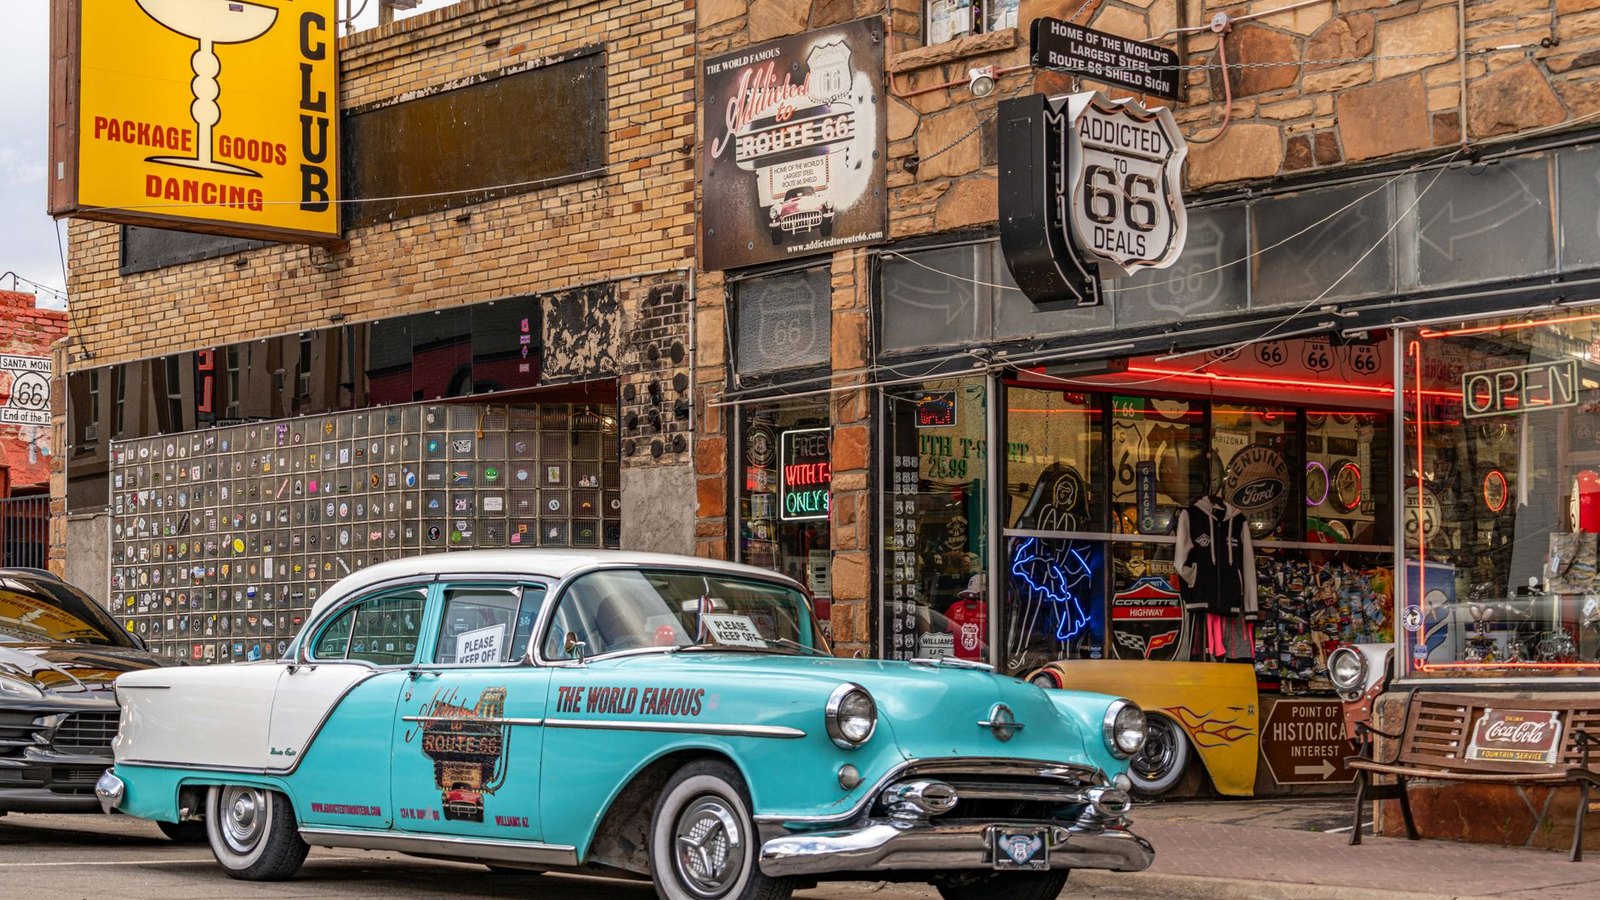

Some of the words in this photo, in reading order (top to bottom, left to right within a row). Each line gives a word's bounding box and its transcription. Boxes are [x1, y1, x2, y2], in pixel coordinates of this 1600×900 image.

[1051, 22, 1083, 42] HOME
[1085, 31, 1100, 45] OF
[1101, 36, 1121, 51] THE
[1123, 41, 1169, 64] WORLD'S
[706, 65, 721, 76] THE
[722, 56, 748, 72] WORLD
[750, 48, 781, 63] FAMOUS
[1070, 42, 1116, 65] LARGEST
[1118, 54, 1151, 73] STEEL
[1049, 52, 1085, 71] ROUTE
[1087, 60, 1104, 76] 66
[1105, 65, 1143, 86] SHIELD
[1144, 77, 1170, 93] SIGN
[299, 12, 329, 213] CLUB
[712, 61, 811, 158] Addicted
[775, 104, 798, 123] to
[94, 116, 192, 152] PACKAGE
[742, 122, 814, 158] ROUTE
[822, 115, 849, 141] 66
[1080, 116, 1162, 154] ADDICTED
[218, 135, 287, 166] GOODS
[774, 165, 788, 175] HOME
[787, 163, 795, 173] OF
[795, 161, 804, 171] THE
[783, 171, 801, 181] LARGEST
[802, 169, 814, 178] STEEL
[1113, 157, 1128, 174] TO
[145, 174, 263, 212] DANCING
[782, 179, 796, 188] ROUTE
[802, 176, 817, 185] SHIELD
[1083, 165, 1160, 232] 66
[787, 230, 883, 253] www.addictedtoroute66.com
[1094, 226, 1146, 257] DEALS
[3, 358, 27, 369] SANTA
[1261, 345, 1282, 363] 66
[1308, 351, 1329, 368] 66
[1355, 355, 1375, 371] 66
[18, 382, 42, 407] 66
[1468, 364, 1571, 413] OPEN
[3, 410, 19, 421] End
[20, 411, 29, 421] of
[30, 412, 42, 423] the
[793, 435, 827, 457] FREE
[920, 434, 953, 457] ITH
[1215, 436, 1244, 445] ARIZONA
[785, 463, 817, 486] WITH
[1227, 448, 1287, 488] GENUINE
[786, 490, 822, 513] ONLY
[1142, 467, 1151, 517] GARAGE
[1242, 483, 1275, 505] Ford
[1249, 506, 1280, 521] ARTS
[1129, 608, 1164, 617] HIGHWAY
[714, 620, 750, 633] PLEASE
[717, 631, 745, 642] KEEP
[746, 632, 762, 643] OFF
[464, 636, 495, 653] PLEASE
[460, 654, 480, 664] KEEP
[481, 649, 497, 663] OFF
[556, 686, 583, 713] THE
[586, 687, 637, 715] WORLD
[639, 688, 706, 716] FAMOUS
[1292, 707, 1322, 718] POINT
[1325, 707, 1338, 717] OF
[1273, 723, 1347, 741] HISTORICA
[1485, 720, 1548, 743] Coca-Cola
[425, 735, 476, 753] ROUTE
[479, 737, 497, 754] 66
[1291, 745, 1339, 757] INTEREST
[1481, 750, 1513, 759] FOUNTAIN
[1517, 752, 1542, 760] SERVICE
[495, 816, 521, 828] WILLIAMS
[522, 817, 530, 828] AZ
